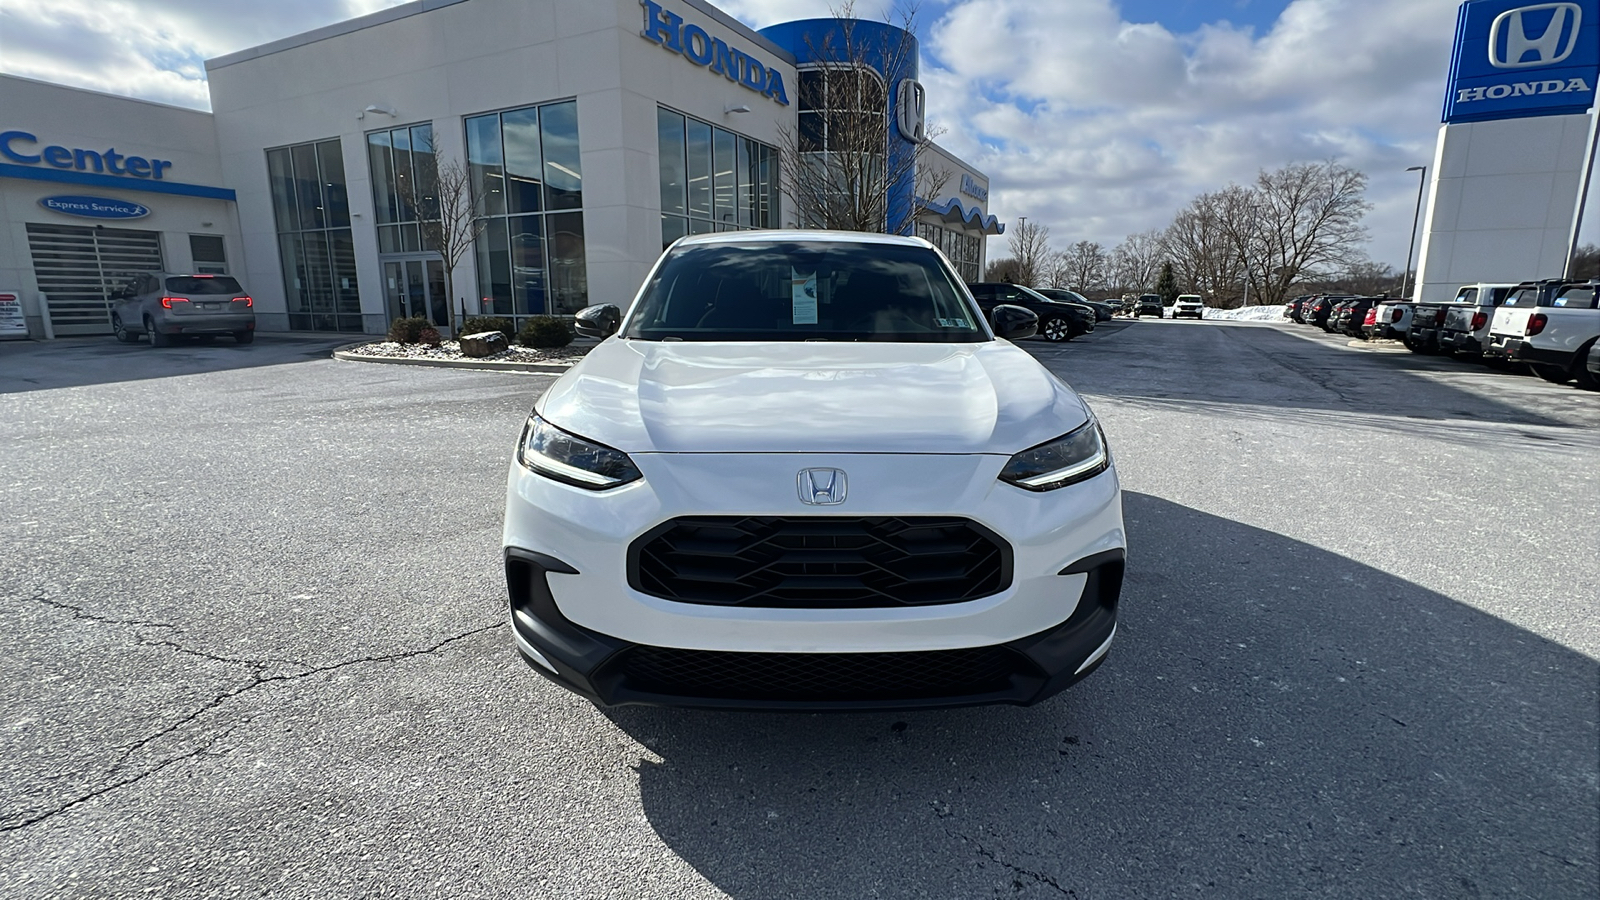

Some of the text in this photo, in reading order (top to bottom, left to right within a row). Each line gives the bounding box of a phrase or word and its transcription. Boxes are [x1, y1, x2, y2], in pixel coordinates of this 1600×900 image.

[639, 0, 790, 106] HONDA
[1457, 78, 1590, 102] HONDA
[0, 131, 171, 179] Center
[47, 199, 129, 213] Express Service
